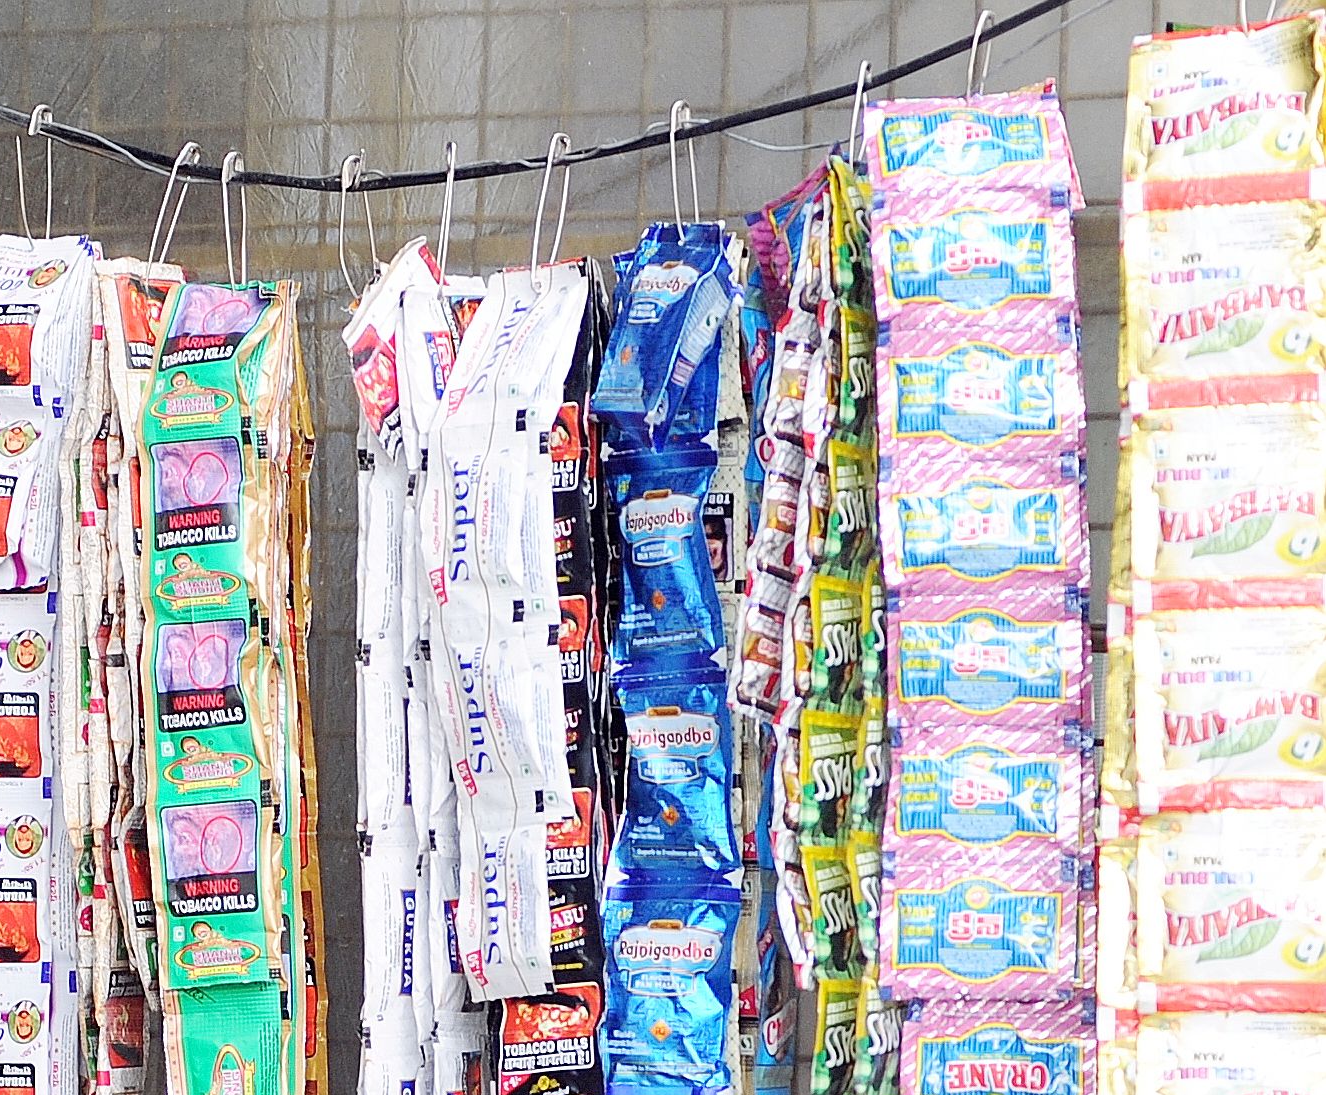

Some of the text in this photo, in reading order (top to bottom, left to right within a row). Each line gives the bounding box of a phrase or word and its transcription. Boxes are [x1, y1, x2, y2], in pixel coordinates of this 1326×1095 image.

[161, 349, 204, 369] TOBACCO
[205, 345, 233, 360] KILLS
[467, 298, 530, 395] Super
[168, 509, 221, 528] WARNING
[450, 460, 477, 582] Super
[156, 525, 237, 548] TOBACCO KILLS
[172, 693, 225, 710] WARNING
[161, 708, 244, 730] TOBACCO KILLS
[458, 654, 496, 775] Super
[1164, 690, 1320, 747] BAMAIYA
[184, 879, 239, 896] WARNING
[172, 894, 256, 914] TOBACCO KILLS
[483, 843, 510, 966] Super
[401, 896, 416, 989] GUTKHA
[618, 940, 714, 962] Rajnigandha
[503, 1036, 589, 1058] TOBACCO KILLS
[945, 1061, 1049, 1093] CRANE
